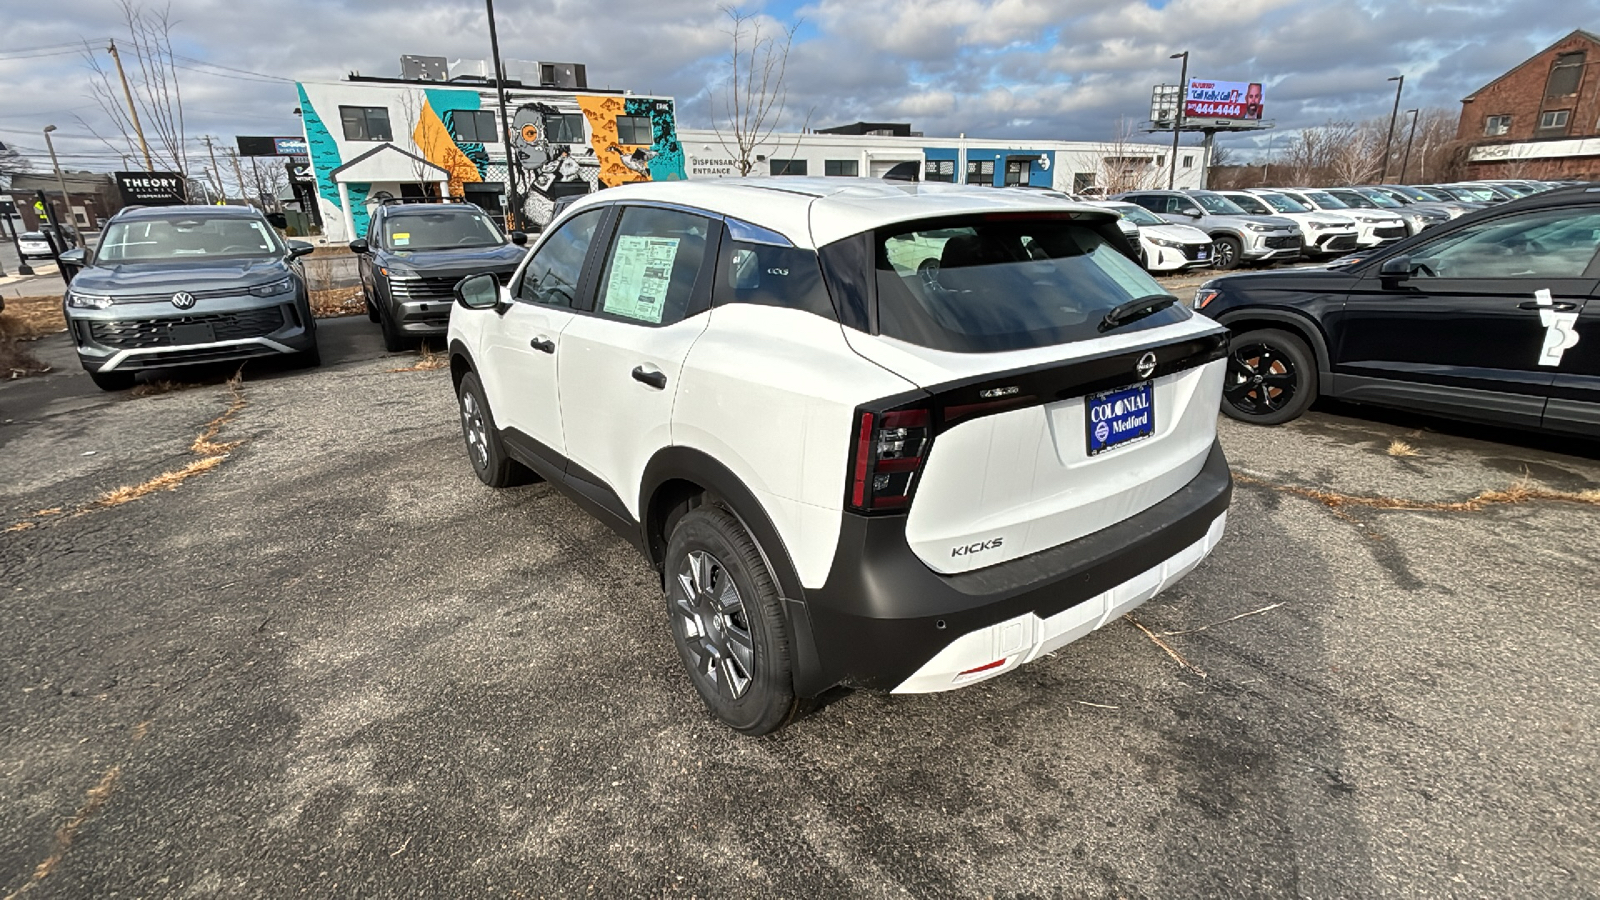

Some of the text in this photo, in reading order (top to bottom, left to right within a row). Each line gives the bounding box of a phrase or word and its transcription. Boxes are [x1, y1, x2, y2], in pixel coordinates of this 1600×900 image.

[692, 167, 731, 175] ENTRANCE
[123, 178, 177, 187] THEORY
[1091, 393, 1149, 423] COLONIAL
[1113, 411, 1148, 434] Medford
[951, 537, 1003, 557] KICKS
